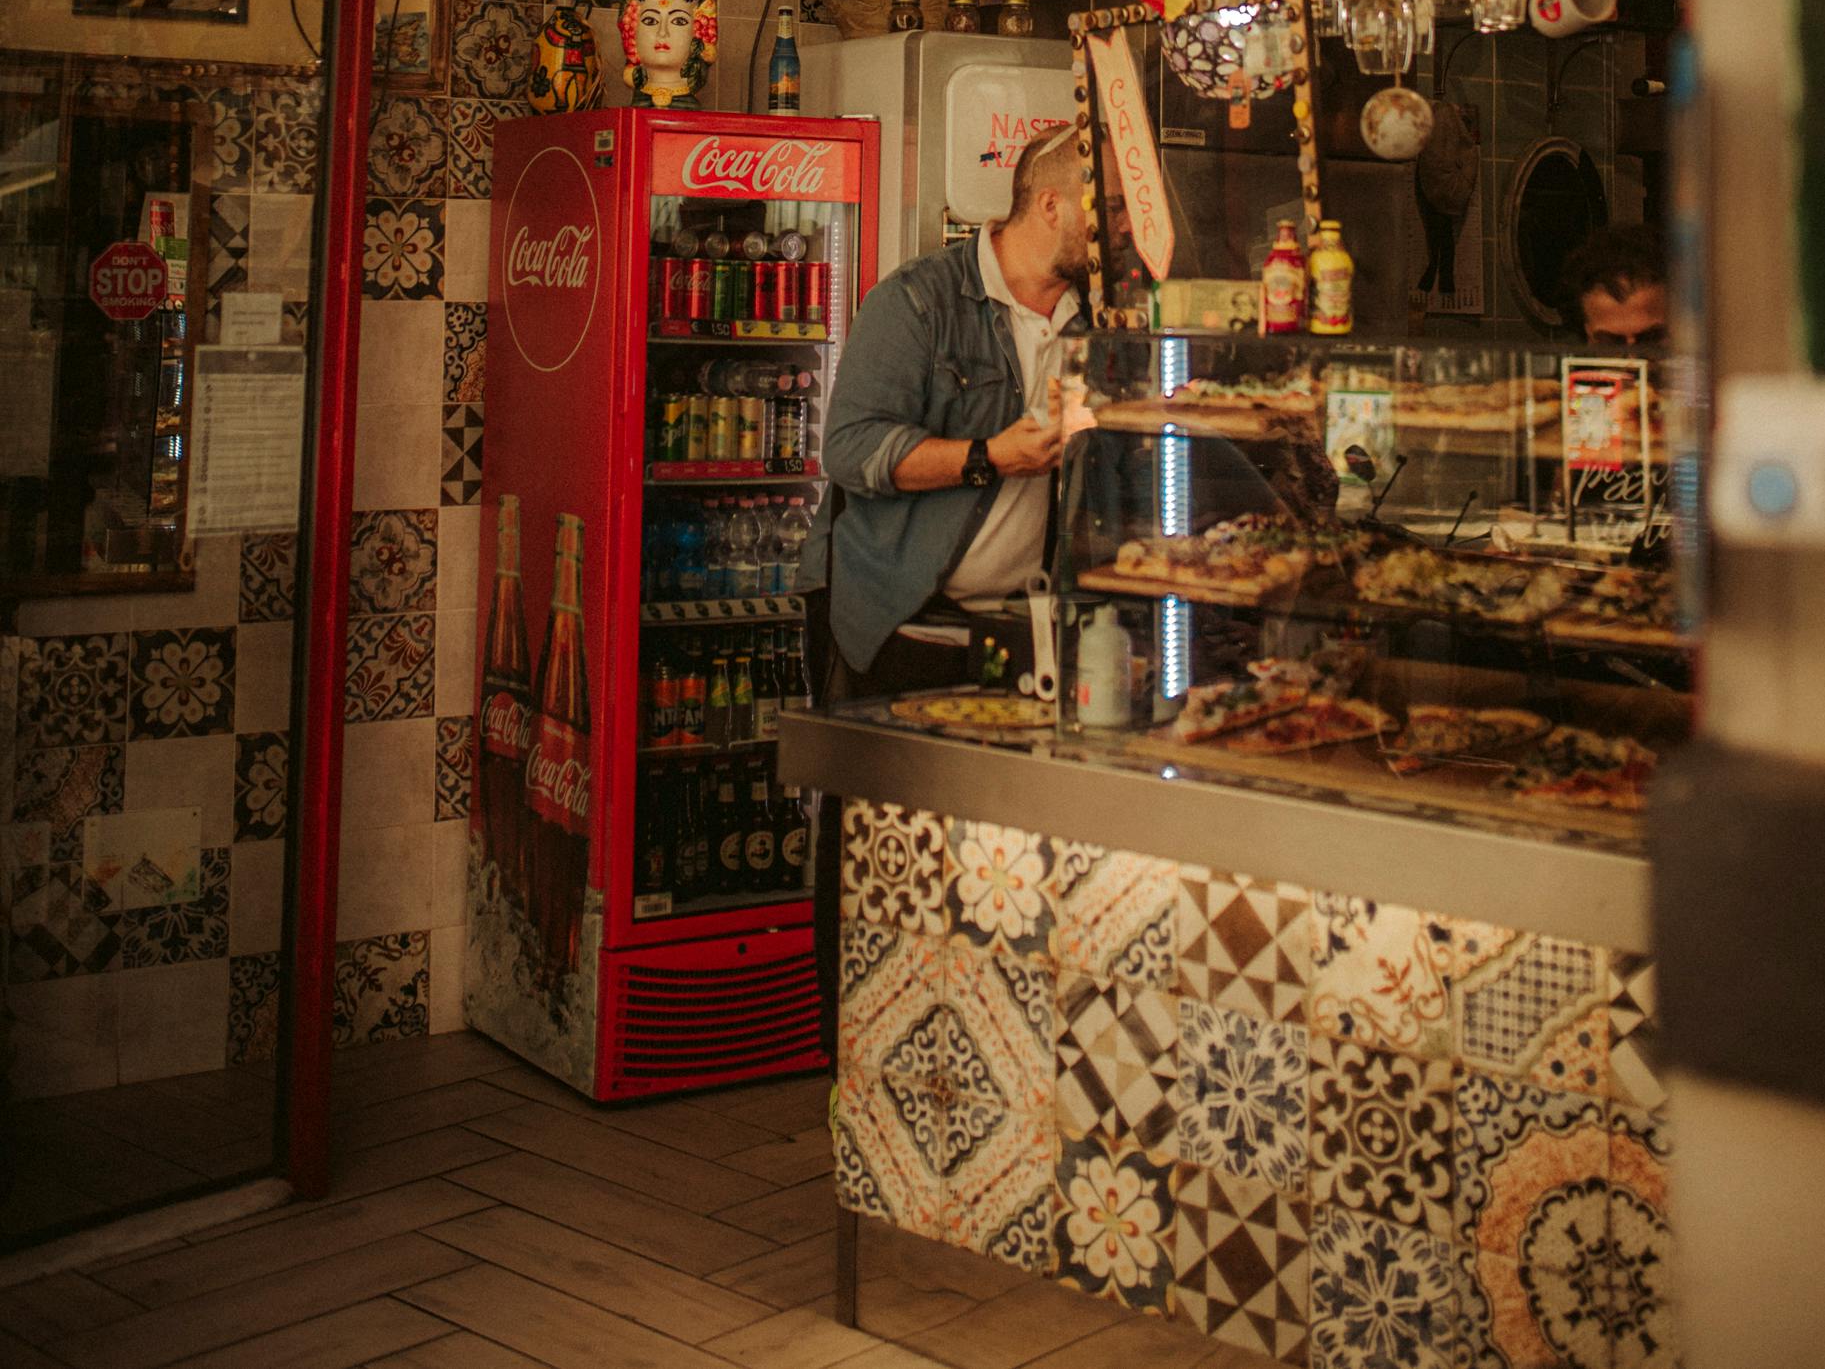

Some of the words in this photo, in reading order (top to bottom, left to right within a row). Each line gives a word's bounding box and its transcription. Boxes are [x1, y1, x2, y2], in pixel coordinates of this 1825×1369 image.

[682, 136, 833, 193] Coca-Cola
[980, 141, 1026, 168] AZ
[1109, 78, 1157, 241] CASSA
[95, 267, 163, 296] STOP
[508, 225, 595, 288] Coca-Cola
[102, 296, 157, 308] SMOKING
[480, 694, 532, 750] Coca-Cola
[526, 743, 592, 818] Coca-Cola
